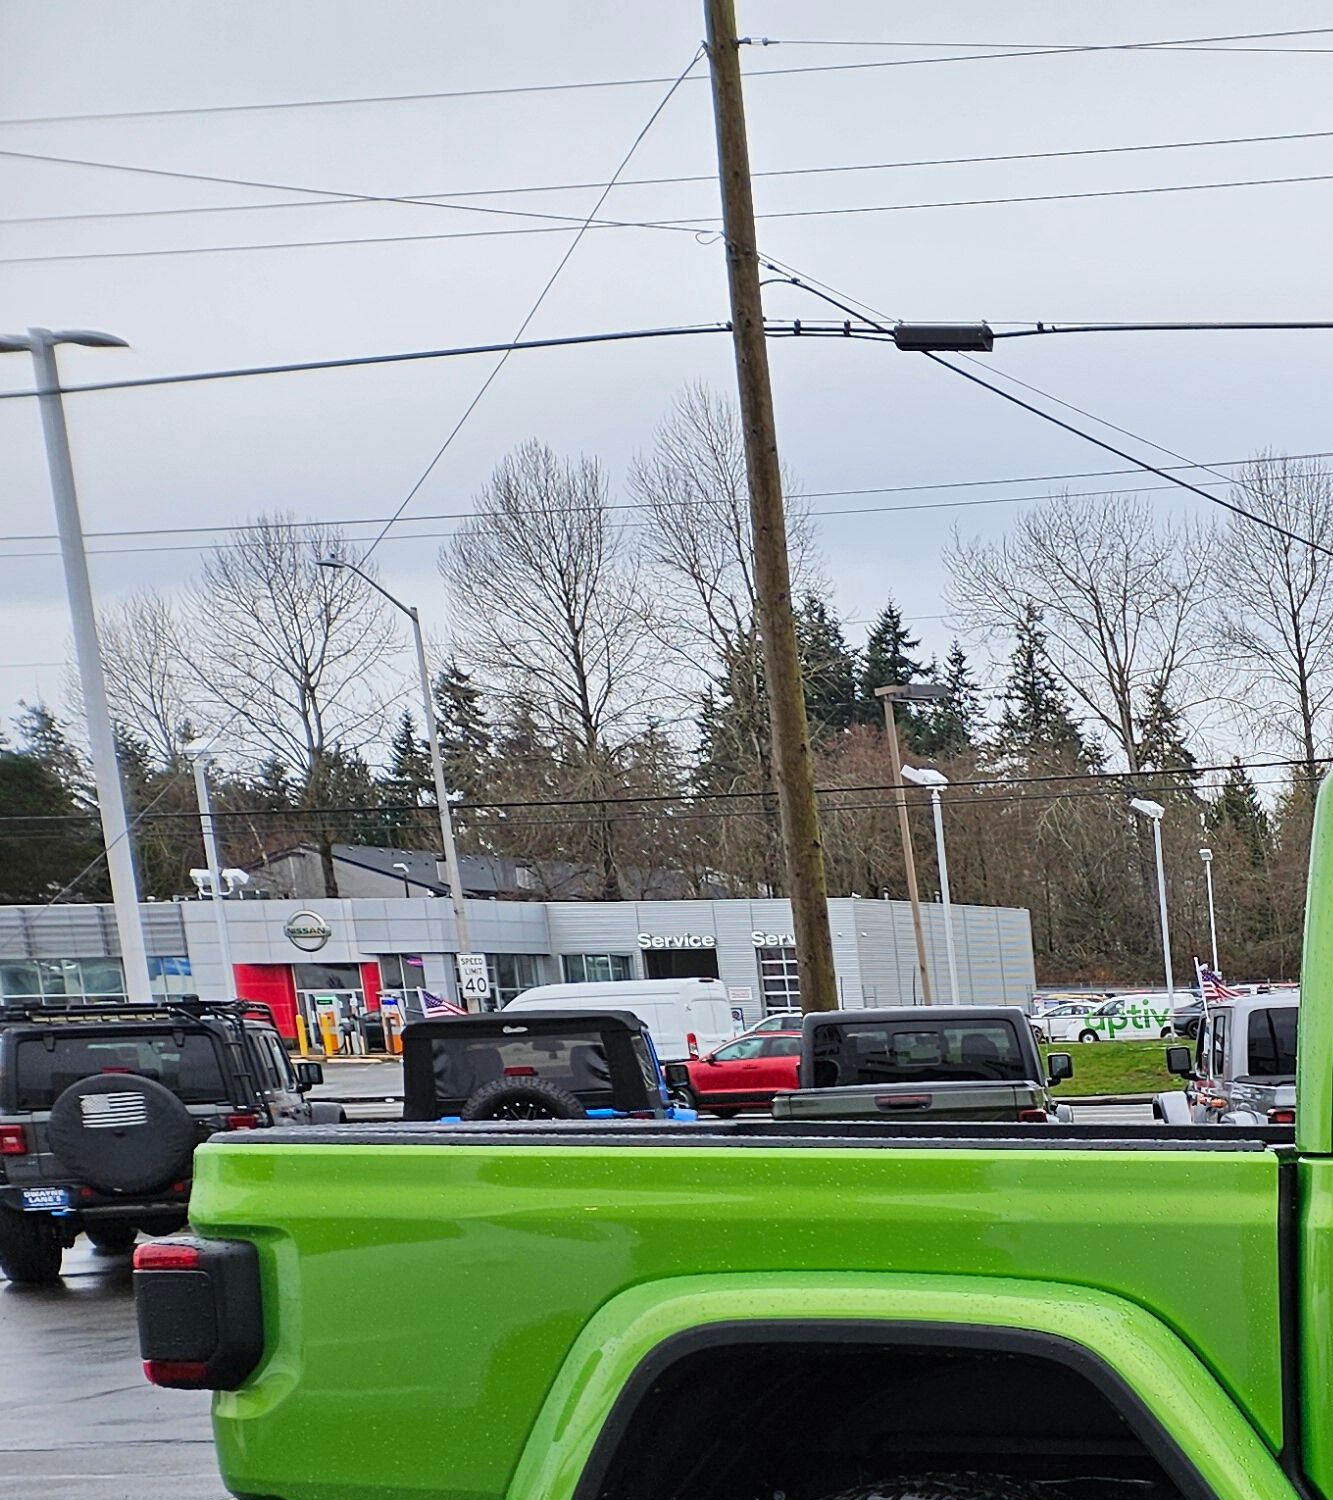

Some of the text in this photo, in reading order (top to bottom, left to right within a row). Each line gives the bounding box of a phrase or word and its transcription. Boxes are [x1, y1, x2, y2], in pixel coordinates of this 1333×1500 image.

[286, 926, 326, 935] NISSAN
[751, 930, 796, 946] Serv
[637, 932, 716, 948] Service
[460, 957, 483, 965] SPEED
[465, 977, 487, 992] 40
[1084, 998, 1170, 1039] aptiv
